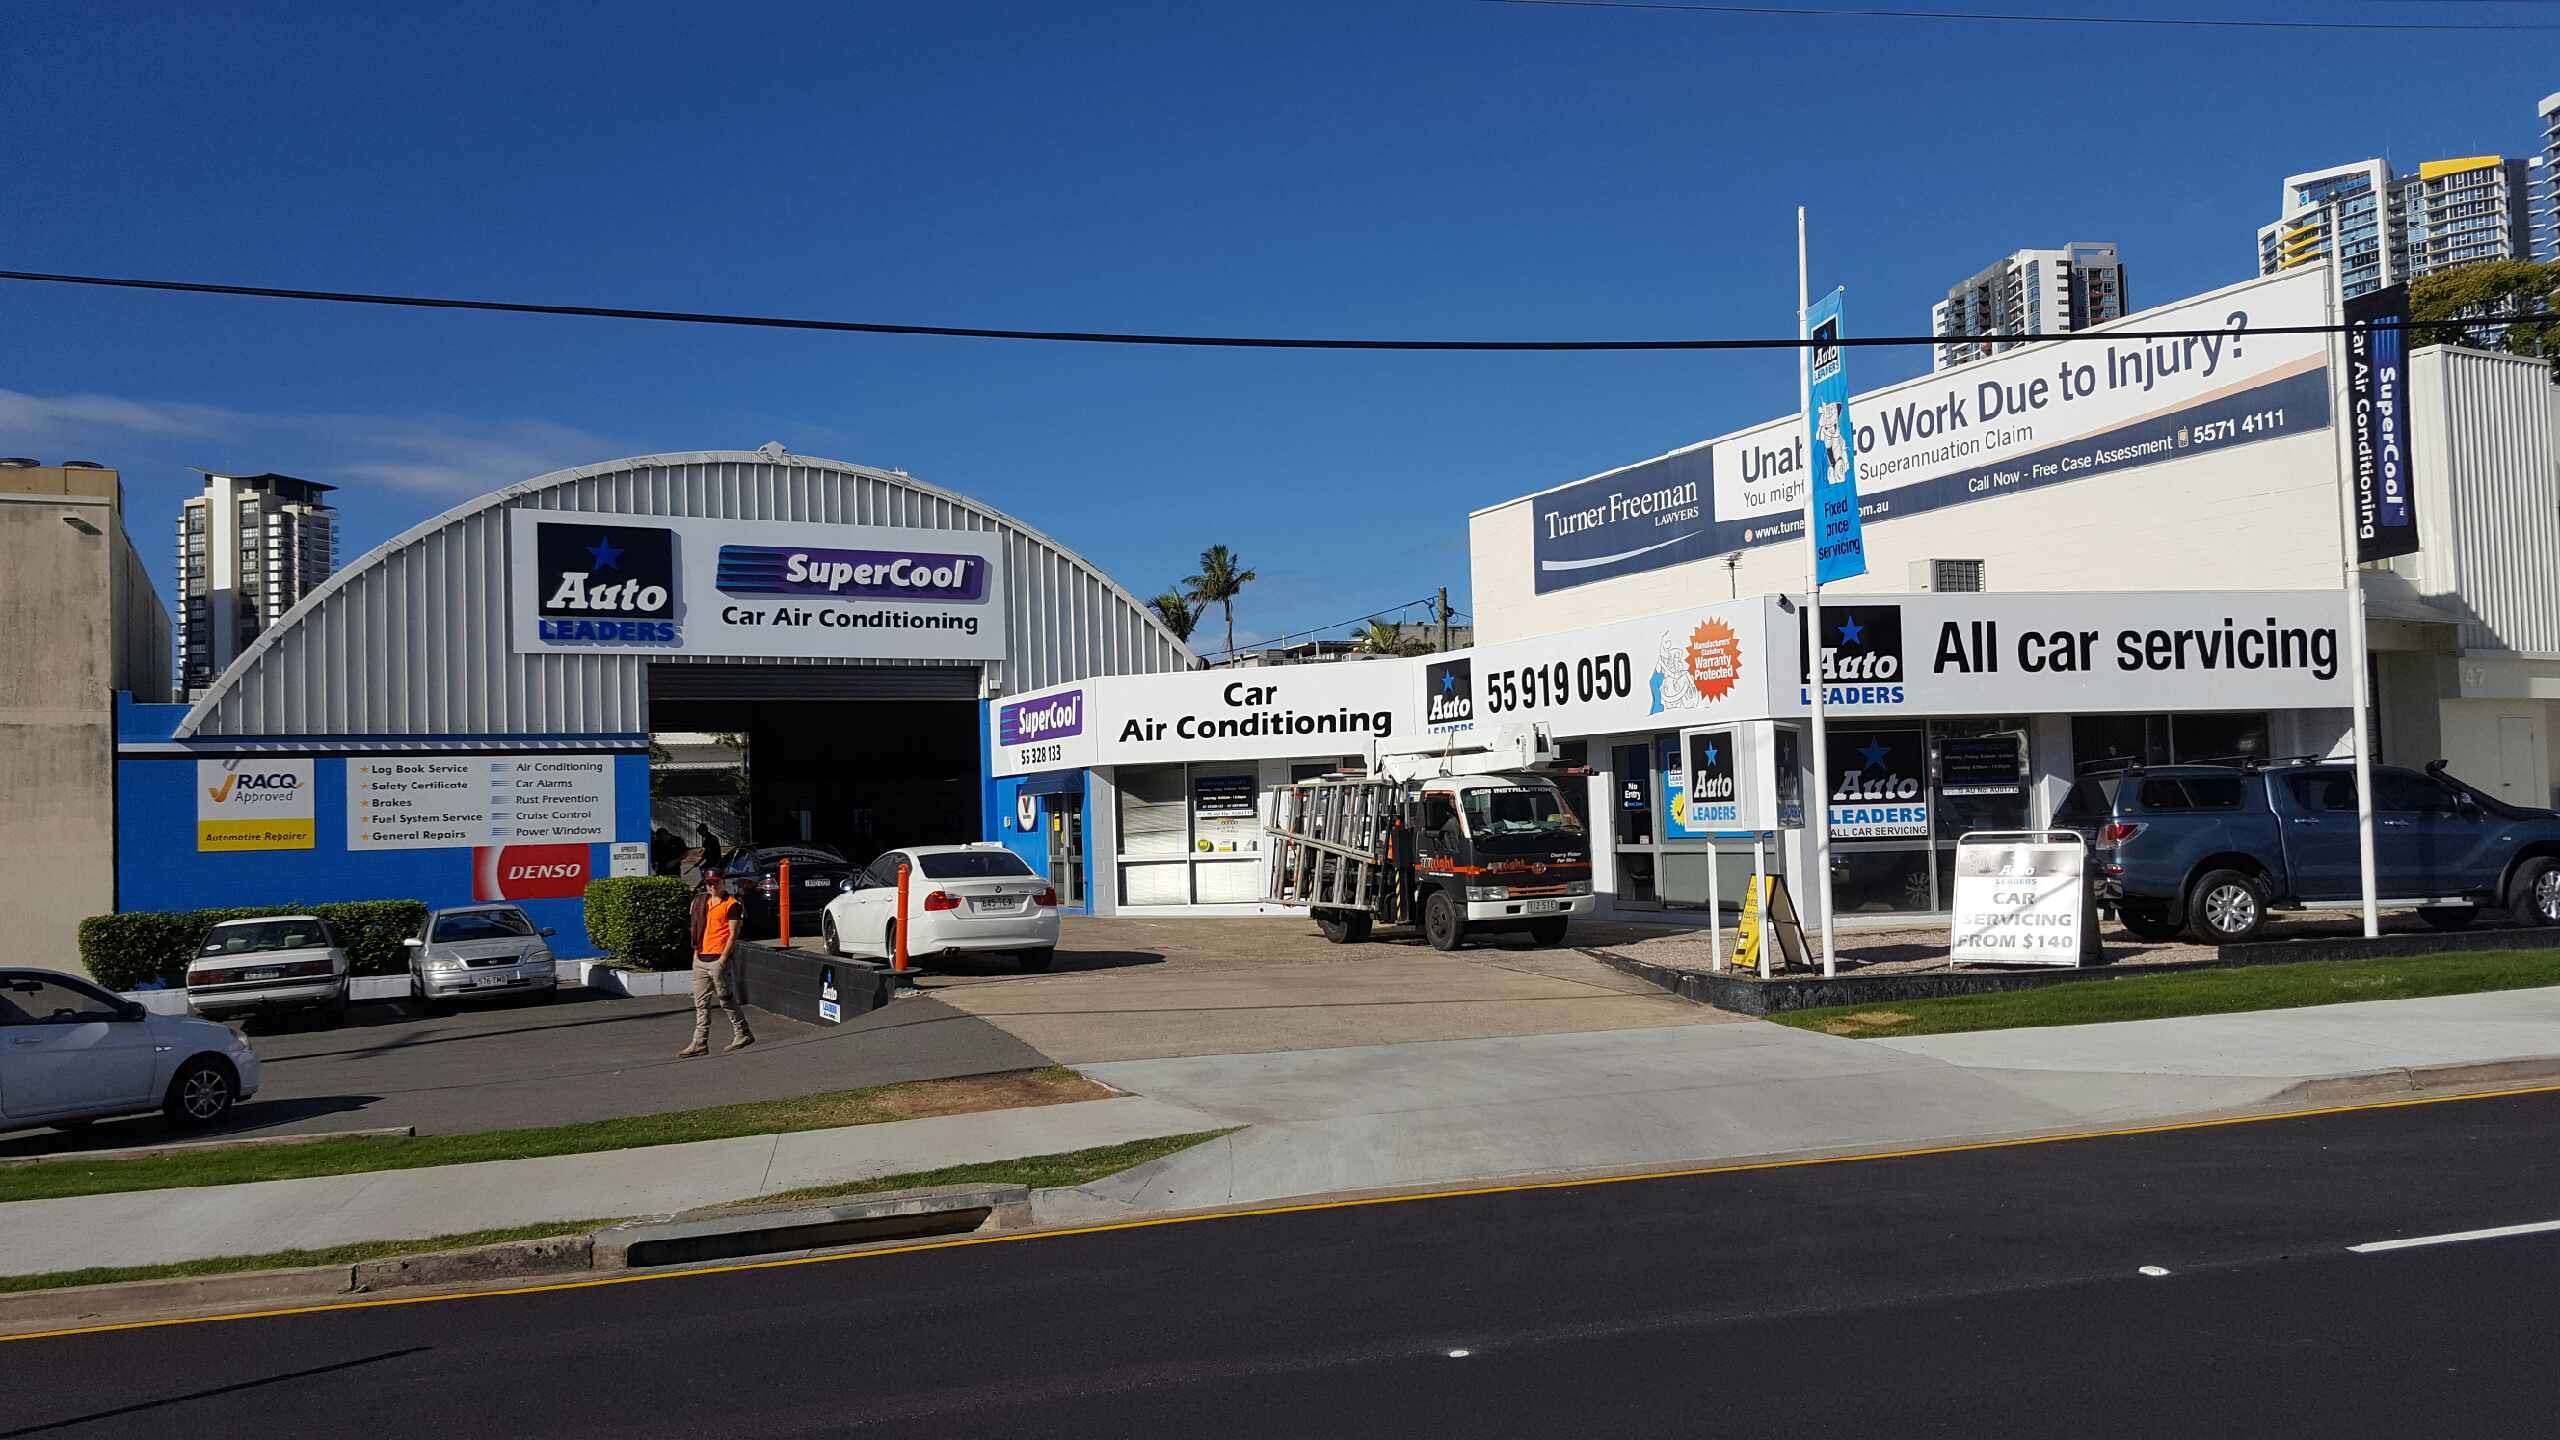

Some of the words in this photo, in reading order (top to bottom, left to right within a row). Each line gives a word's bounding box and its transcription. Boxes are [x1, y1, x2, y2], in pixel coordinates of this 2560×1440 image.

[2352, 319, 2366, 356] Car
[1815, 344, 1837, 368] Auto
[1850, 421, 1875, 456] to
[1881, 391, 1968, 443] Work
[1979, 374, 2048, 422] Due
[2058, 361, 2096, 401] to
[2107, 310, 2249, 391] Injury?
[2354, 361, 2369, 392] Air
[2193, 417, 2236, 445] 5571
[2242, 408, 2285, 434] 4111
[2376, 367, 2403, 504] SuperCool
[1743, 491, 1766, 508] You
[1859, 437, 1980, 481] Superannuation
[1985, 425, 2033, 450] Claim
[1968, 475, 1990, 493] Call
[1993, 469, 2020, 487] Now
[2032, 461, 2058, 479] Free
[2061, 455, 2092, 473] Case
[2095, 435, 2173, 467] Assessment
[2356, 399, 2375, 539] Conditioning
[1544, 504, 1607, 540] Turner
[1608, 480, 1698, 523] Freeman
[1654, 506, 1699, 527] LAWYERS
[1824, 498, 1848, 519] Fixed
[1826, 518, 1849, 539] price
[1818, 537, 1861, 561] servicing
[546, 571, 669, 612] Auto
[538, 618, 675, 643] LEADERS
[722, 606, 765, 627] Car
[772, 607, 813, 629] Air
[818, 608, 979, 635] Conditioning
[1933, 620, 1999, 674] All
[2017, 630, 2099, 673] car
[2116, 617, 2338, 681] servicing
[1695, 654, 1732, 669] Warranty
[1805, 646, 1899, 684] Auto
[1577, 651, 1632, 704] 050
[1694, 664, 1734, 681] Protected
[2465, 668, 2486, 688] 47
[1223, 681, 1279, 707] Car
[1429, 694, 1471, 721] Auto
[1118, 717, 1168, 743] Air
[1176, 708, 1393, 738] Conditioning
[1031, 746, 1046, 764] 328
[1048, 744, 1062, 761] 133
[371, 764, 393, 776] Log
[396, 763, 425, 775] Book
[428, 763, 469, 774] Service
[516, 762, 533, 772] Air
[535, 761, 603, 774] Conditioning
[237, 773, 297, 790] RACQ
[371, 780, 408, 792] Safety
[411, 779, 468, 791] Certificate
[515, 779, 533, 789] Car
[536, 779, 573, 789] Alarms
[1470, 787, 1492, 796] SIGN
[1693, 769, 1733, 799] Auto
[1833, 770, 1919, 801] Auto
[234, 790, 294, 805] Approved
[371, 798, 413, 808] Brakes
[515, 795, 540, 805] Rust
[541, 793, 599, 804] Prevention
[1624, 790, 1642, 800] Entry
[372, 814, 396, 824] Fuel
[399, 812, 440, 825] System
[442, 812, 483, 823] Service
[515, 811, 549, 821] Cruise
[551, 810, 592, 820] Control
[1692, 805, 1737, 822] LEADERS
[1828, 807, 1926, 825] LEADERS
[205, 832, 262, 842] Automotive
[264, 831, 309, 842] Repairer
[372, 830, 419, 842] General
[422, 829, 466, 842] Repairs
[515, 827, 549, 837] Power
[551, 825, 602, 837] Windows
[1830, 828, 1849, 836] ALL
[1852, 827, 1873, 836] CAR
[1875, 825, 1927, 836] SERVICING
[507, 863, 582, 881] DENSO
[1992, 892, 2036, 905] CAR
[1962, 913, 2072, 927] SERVICING
[1957, 934, 2016, 948] FROM
[2022, 933, 2073, 950] $140
[822, 981, 838, 1001] Auto
